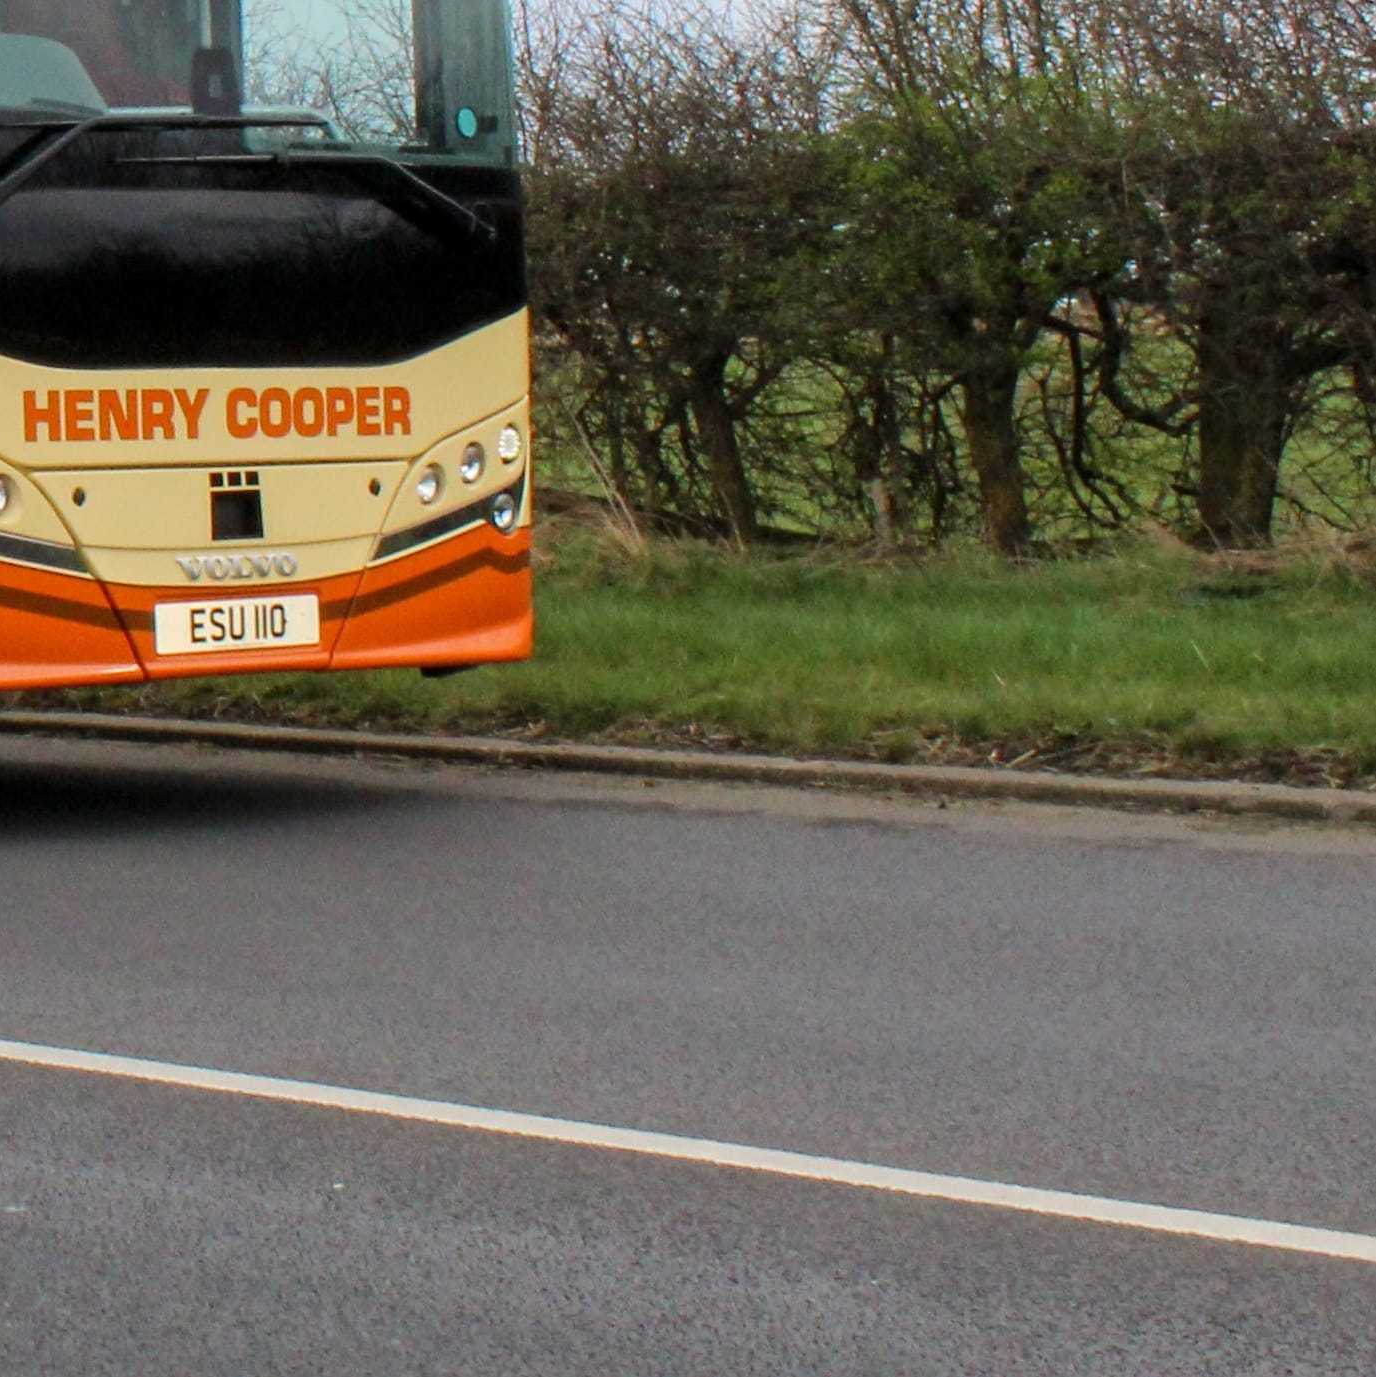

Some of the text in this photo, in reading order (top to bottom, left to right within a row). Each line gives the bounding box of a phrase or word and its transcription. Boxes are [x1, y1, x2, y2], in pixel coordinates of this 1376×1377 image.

[23, 386, 412, 442] HENRY COOPER
[175, 552, 298, 581] VOLVO
[189, 603, 288, 644] ESU 110
